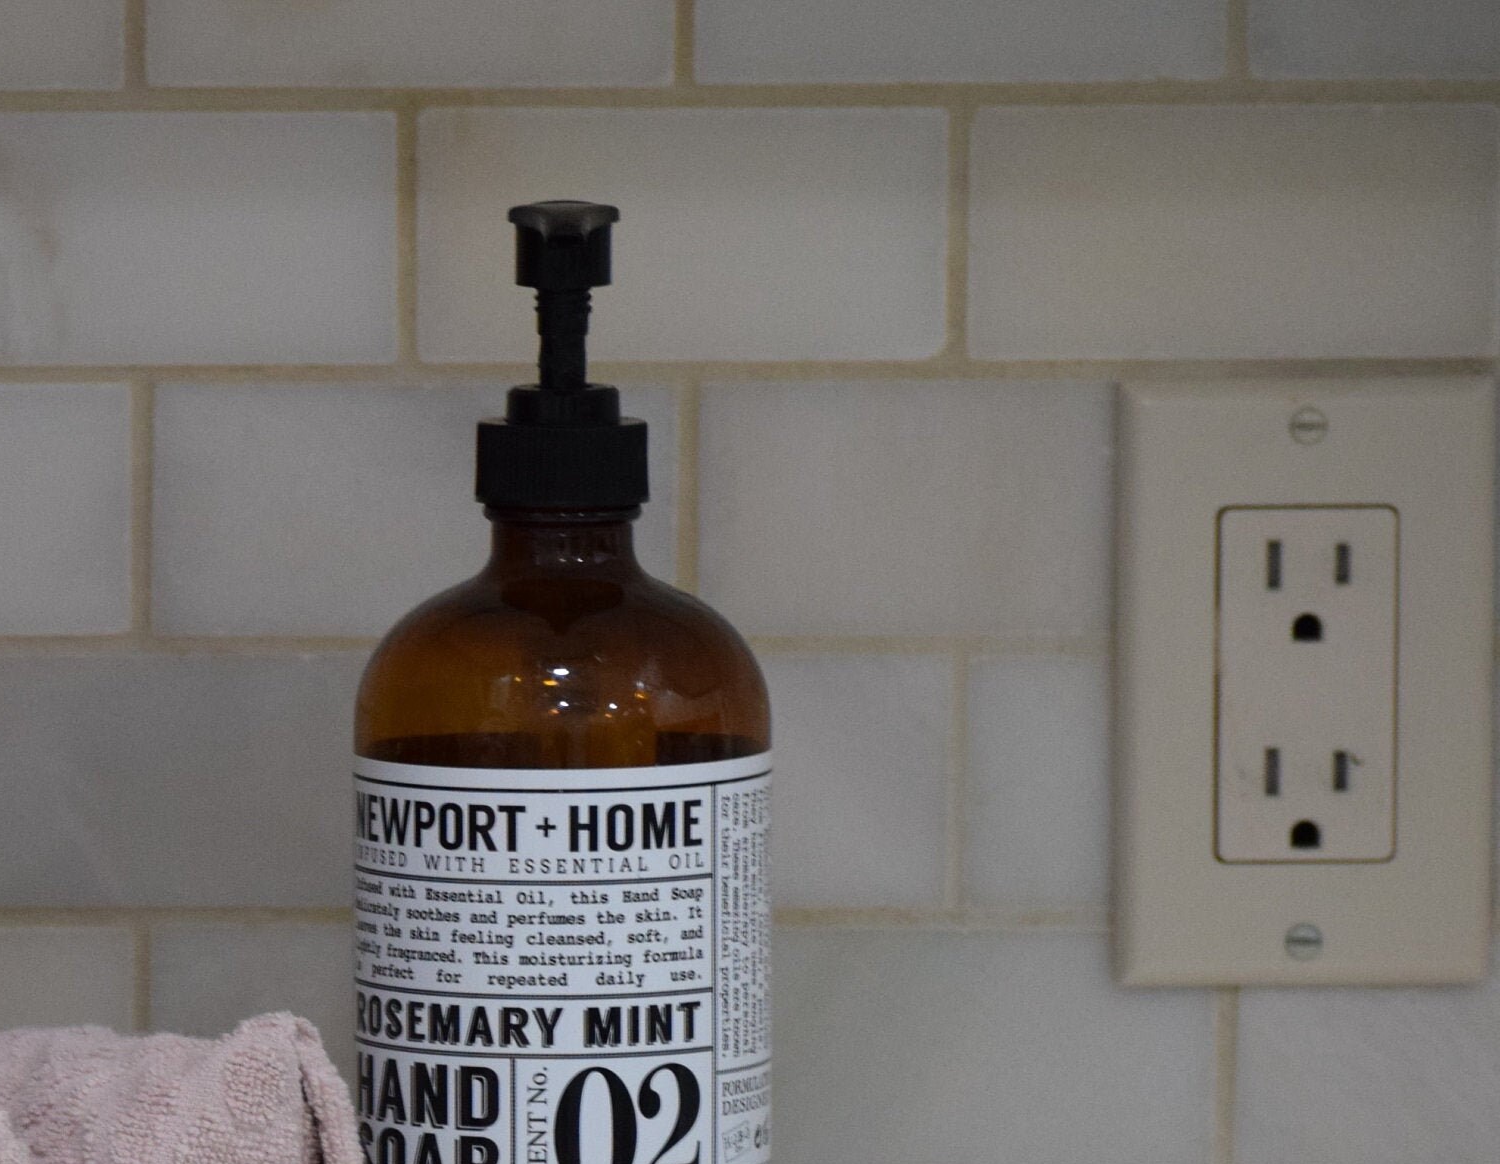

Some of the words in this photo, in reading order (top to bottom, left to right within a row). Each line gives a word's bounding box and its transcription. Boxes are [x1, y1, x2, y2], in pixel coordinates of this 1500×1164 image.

[356, 791, 526, 852] NEWPORT
[569, 800, 702, 852] HOME
[721, 796, 730, 819] for
[423, 854, 485, 873] WITH
[509, 856, 649, 875] ESSENTIAL
[668, 852, 704, 870] OIL
[721, 828, 730, 868] their
[388, 883, 416, 899] with
[425, 889, 504, 905] Essential
[516, 891, 554, 907] Oil,
[571, 890, 609, 905] this
[622, 888, 659, 903] Hand
[671, 887, 703, 902] Soap
[406, 907, 459, 923] soothes
[470, 910, 498, 924] and
[507, 912, 585, 928] perfumes
[596, 911, 625, 925] the
[635, 909, 678, 923] skin.
[687, 906, 703, 919] It
[721, 874, 731, 959] beneficial
[383, 922, 402, 938] the
[410, 926, 441, 942] skin
[451, 930, 514, 948] feeling
[526, 932, 612, 947] cleansed,
[627, 929, 668, 944] soft,
[680, 925, 703, 940] and
[387, 943, 462, 963] fragranced.
[473, 952, 509, 965] This
[518, 951, 633, 967] moisturizing
[643, 947, 703, 963] formula
[372, 963, 415, 981] perfect
[436, 969, 462, 983] for
[487, 972, 568, 989] repeated
[595, 971, 645, 988] daily
[670, 969, 702, 983] use.
[358, 990, 564, 1049] ROSEMARY
[583, 1001, 701, 1048] MINT
[719, 966, 731, 1058] properties.
[358, 1052, 500, 1131] HAND
[527, 1066, 548, 1106] No.
